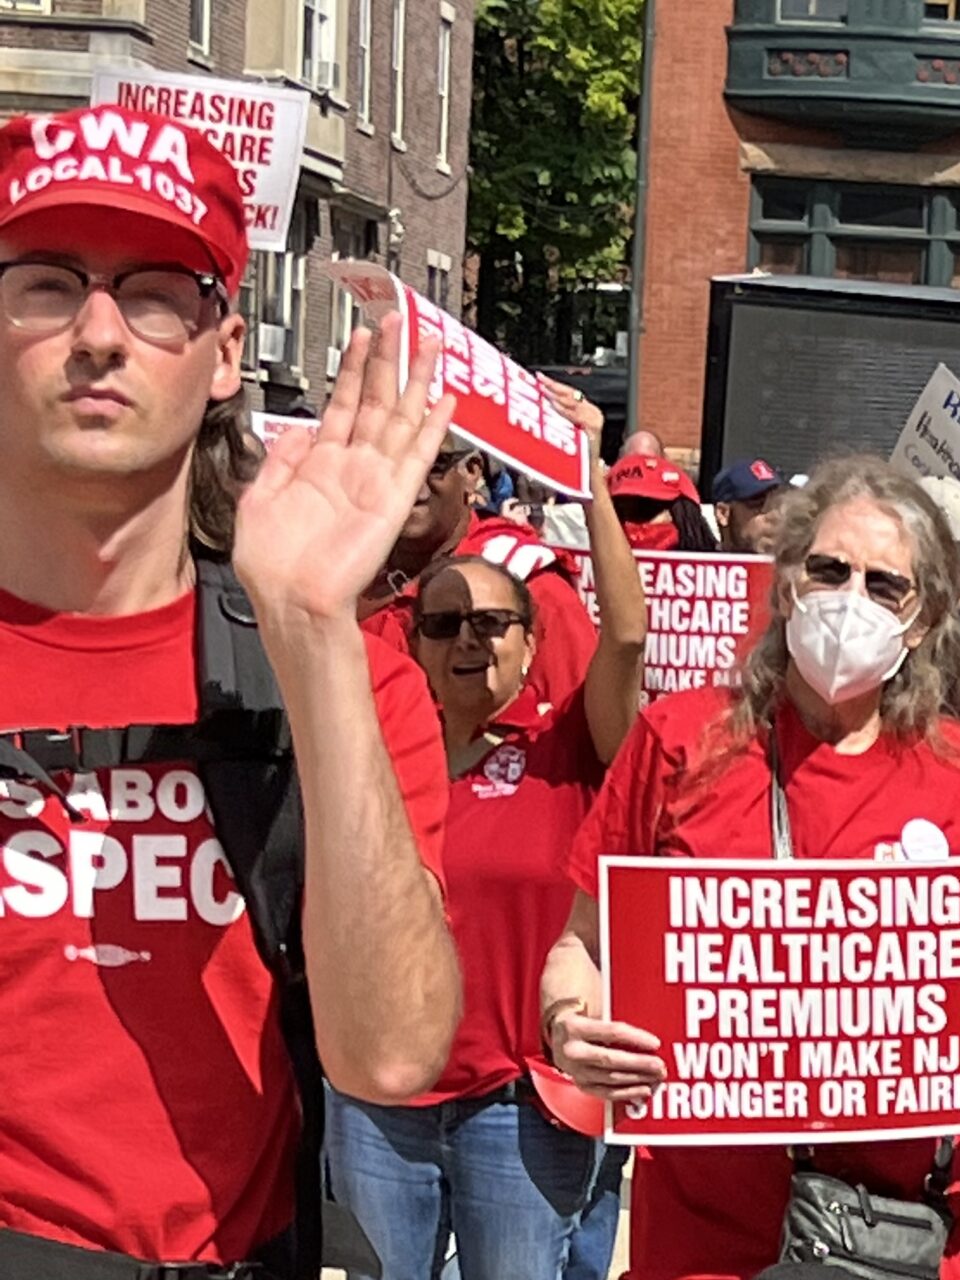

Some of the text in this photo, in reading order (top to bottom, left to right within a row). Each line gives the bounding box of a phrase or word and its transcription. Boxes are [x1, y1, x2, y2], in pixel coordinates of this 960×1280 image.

[117, 82, 275, 131] INCREASING
[31, 111, 195, 184] CWA
[9, 156, 133, 205] LOCAL
[135, 164, 208, 225] 1037
[66, 768, 215, 823] ABO
[0, 829, 246, 926] SPEC
[669, 875, 960, 929] INCREASING
[685, 984, 947, 1038] PREMIUMS
[673, 1036, 960, 1079] WON'T MAKE NJ
[819, 1080, 866, 1117] OR
